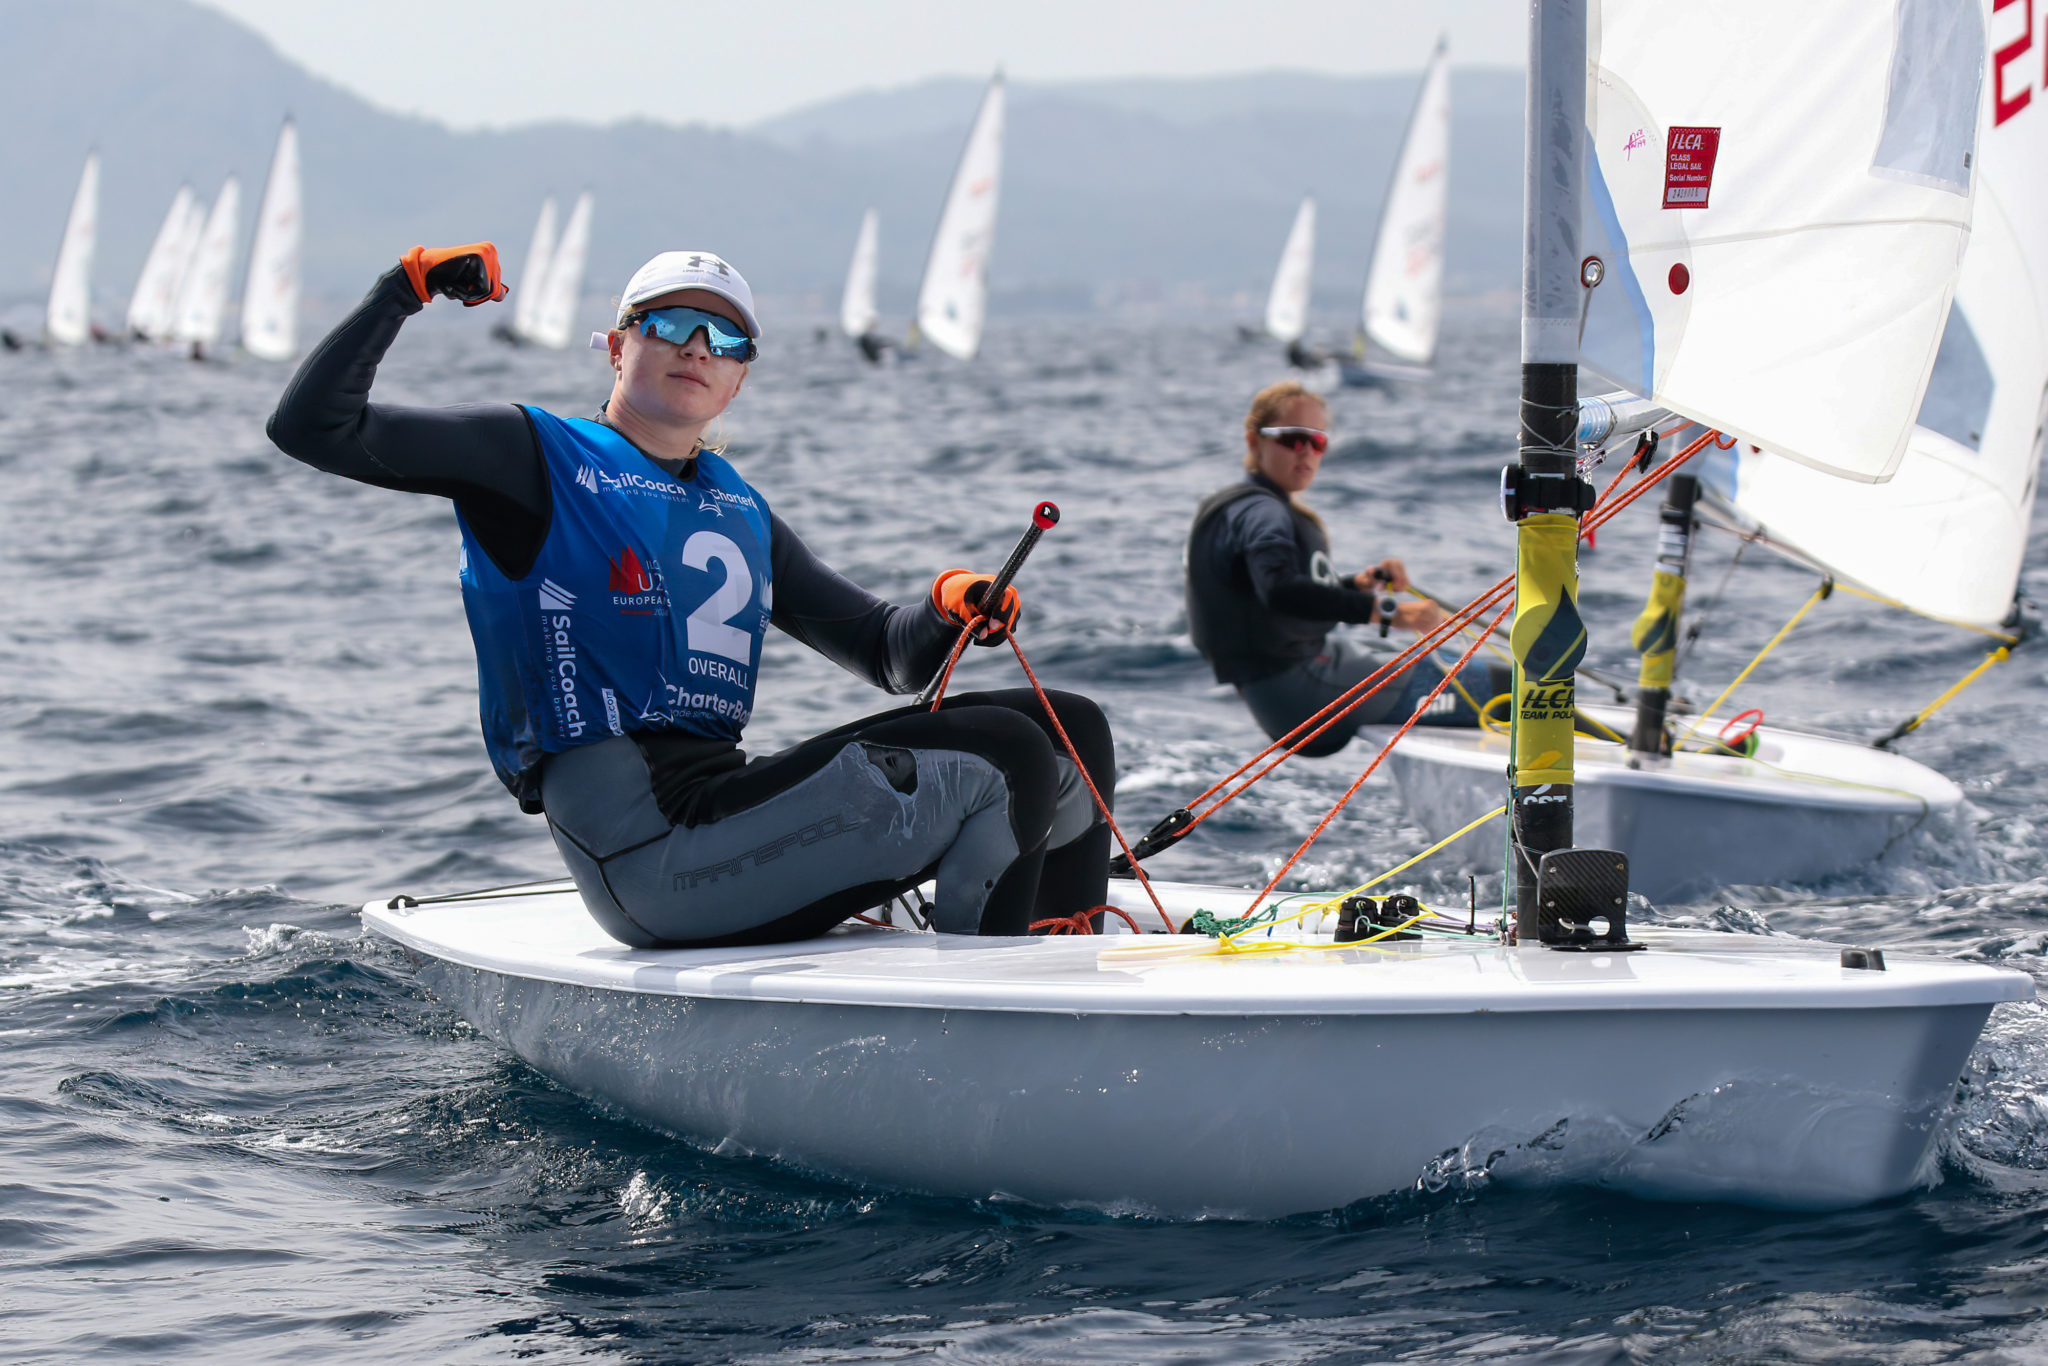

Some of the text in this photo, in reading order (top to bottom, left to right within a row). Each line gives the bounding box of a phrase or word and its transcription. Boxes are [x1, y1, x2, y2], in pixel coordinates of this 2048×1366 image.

[1669, 174, 1686, 182] Serial
[682, 530, 753, 666] 2
[542, 615, 552, 662] making
[550, 668, 558, 691] you
[552, 615, 587, 738] SailCoach
[688, 657, 749, 690] OVERALL
[1520, 710, 1548, 720] TEAM
